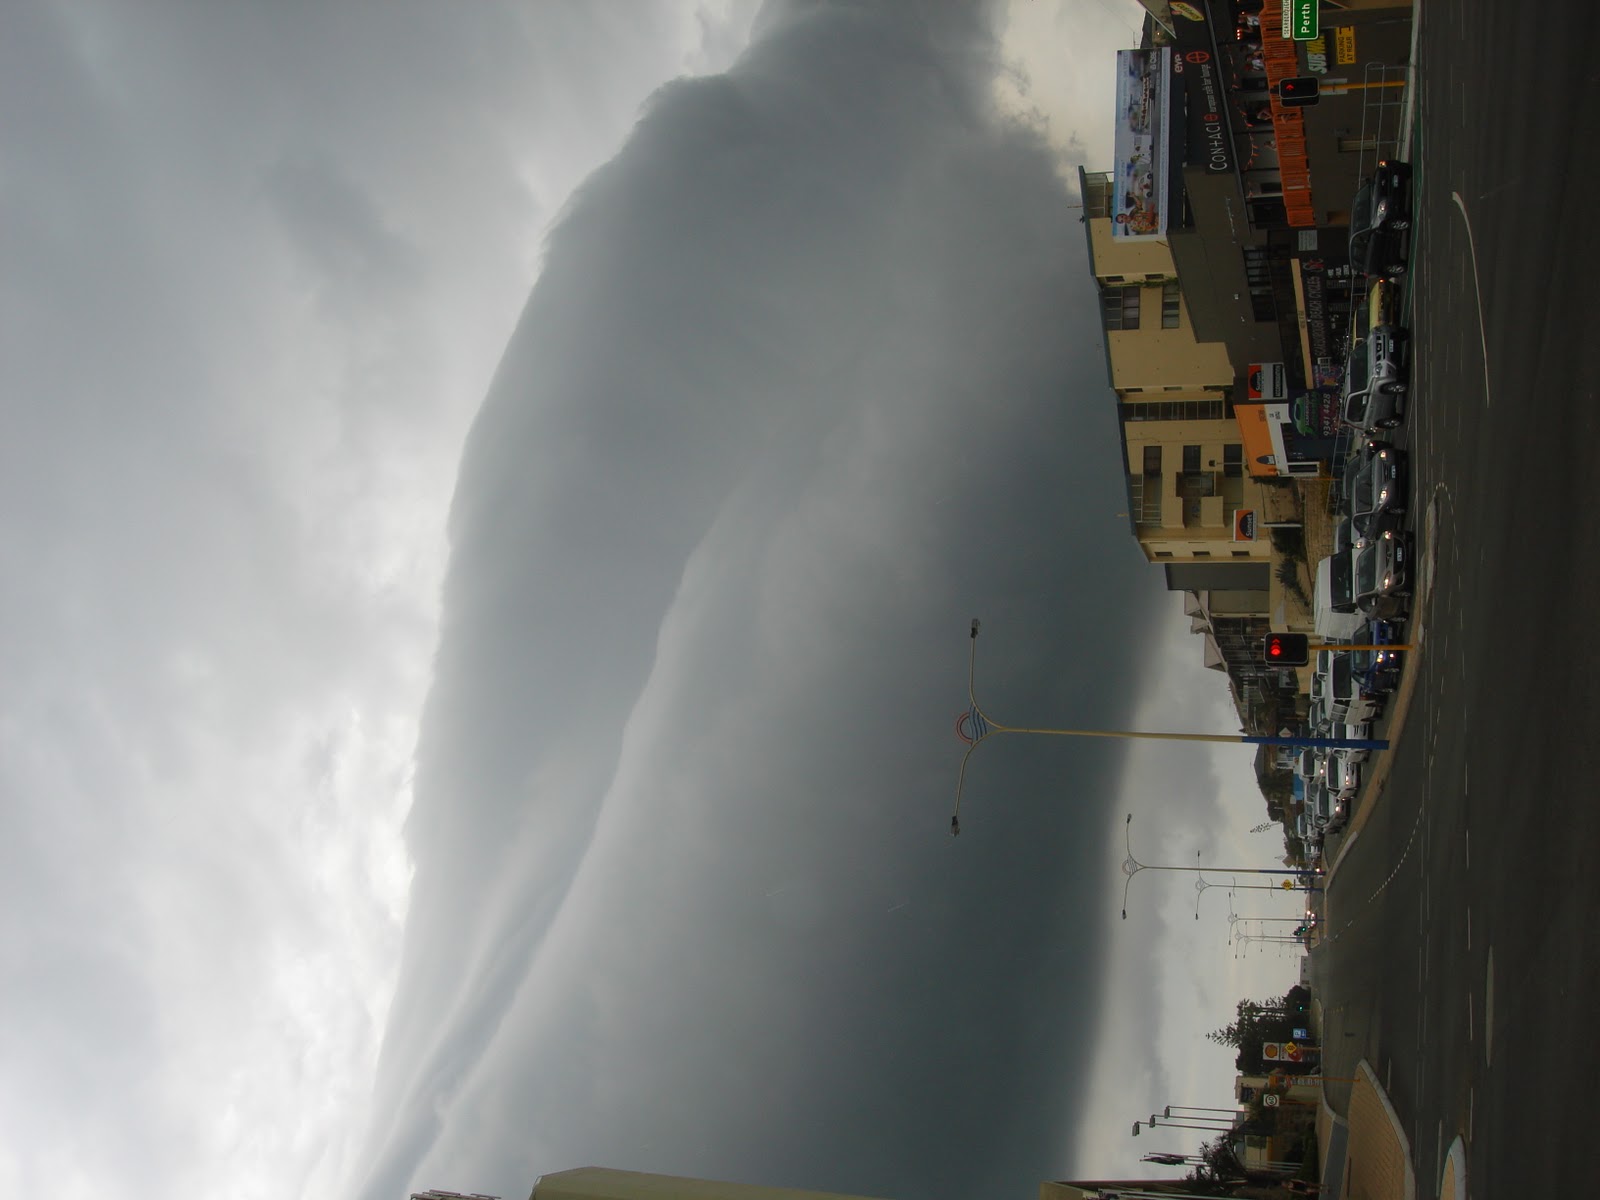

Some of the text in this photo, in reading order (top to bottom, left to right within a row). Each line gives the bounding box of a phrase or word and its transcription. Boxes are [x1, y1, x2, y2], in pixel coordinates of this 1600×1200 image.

[1301, 3, 1310, 33] Perth
[1174, 54, 1183, 73] eye
[1306, 35, 1327, 74] SUBWA
[1306, 276, 1321, 298] CYCLES
[1308, 300, 1322, 319] BEACH
